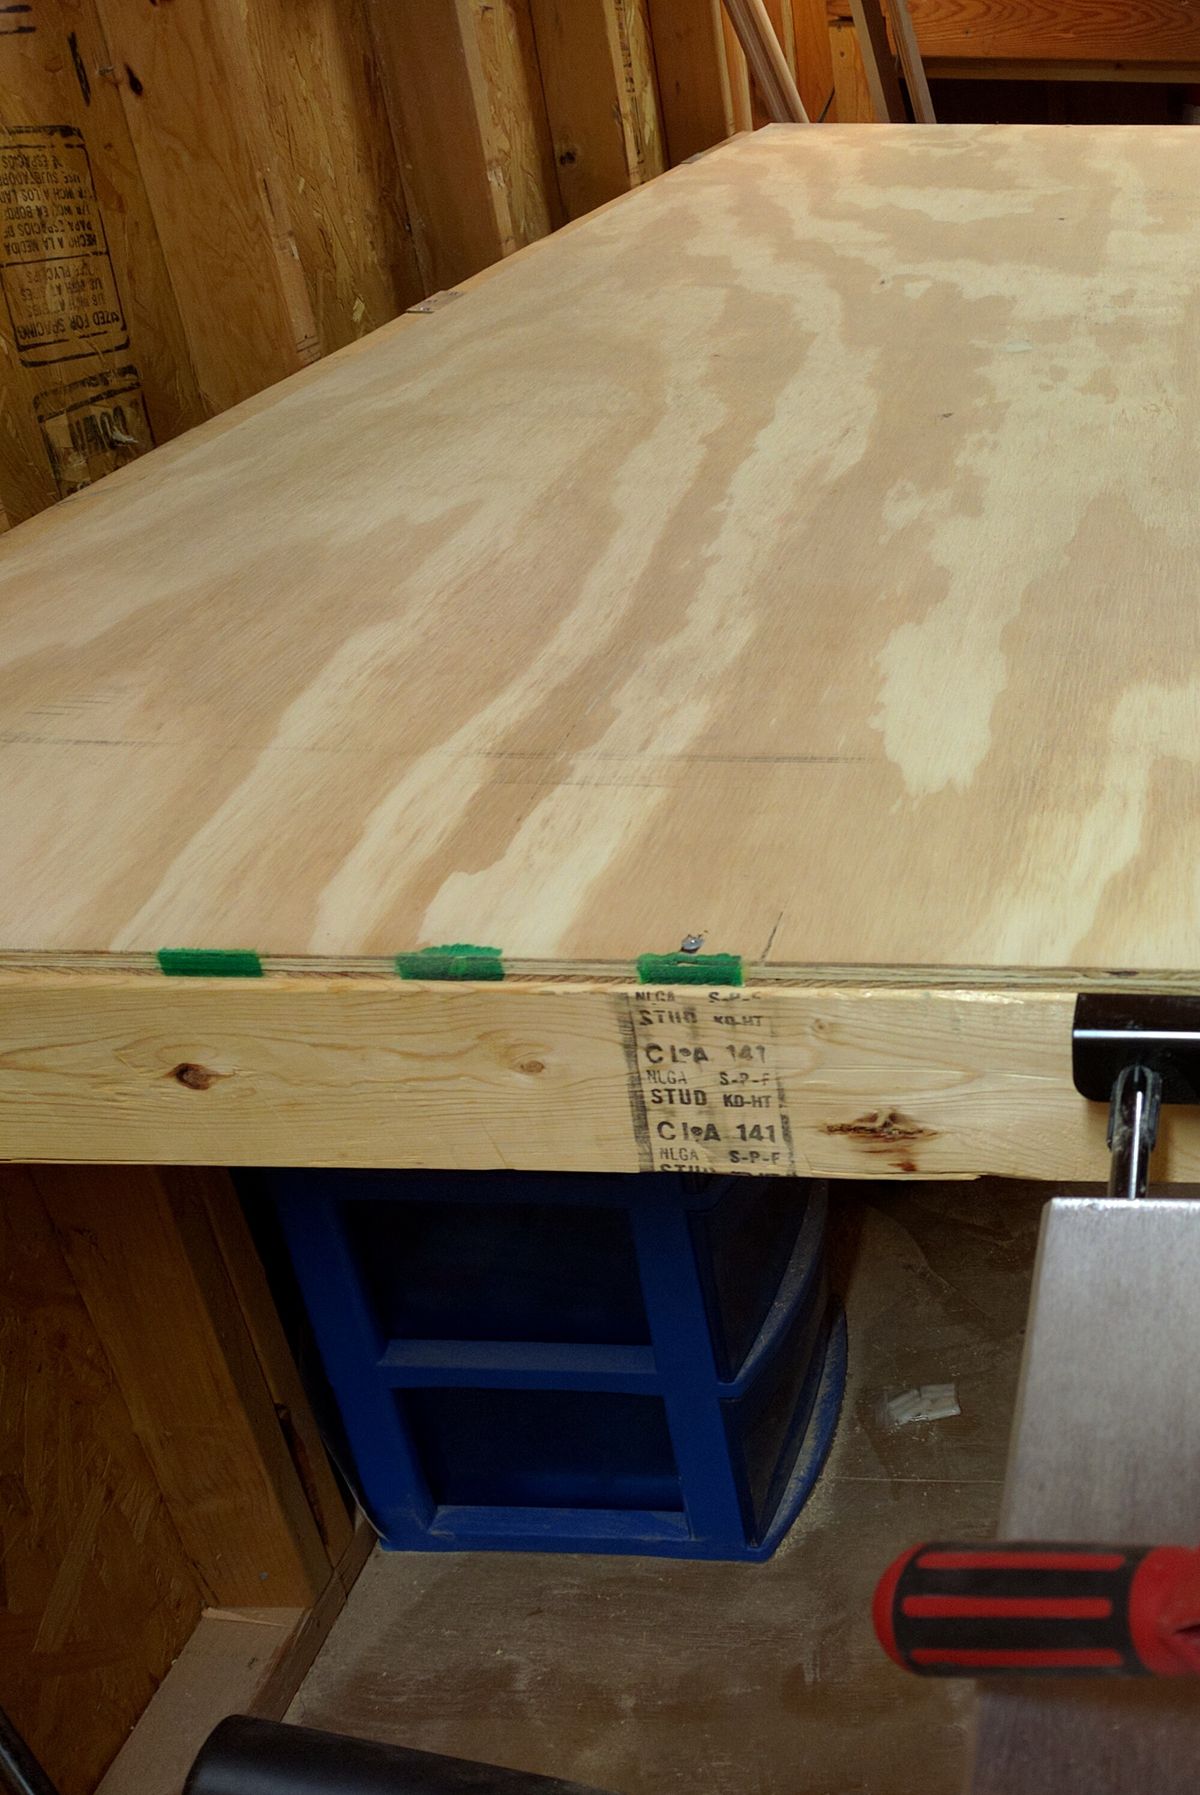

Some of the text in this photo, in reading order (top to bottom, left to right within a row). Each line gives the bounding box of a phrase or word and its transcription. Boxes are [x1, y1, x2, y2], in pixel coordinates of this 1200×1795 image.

[42, 236, 56, 251] LA
[57, 236, 64, 249] A
[651, 1088, 773, 1108] STUD KD-HT
[736, 1123, 776, 1143] 141
[659, 1147, 781, 1165] NLGA S-P-F
